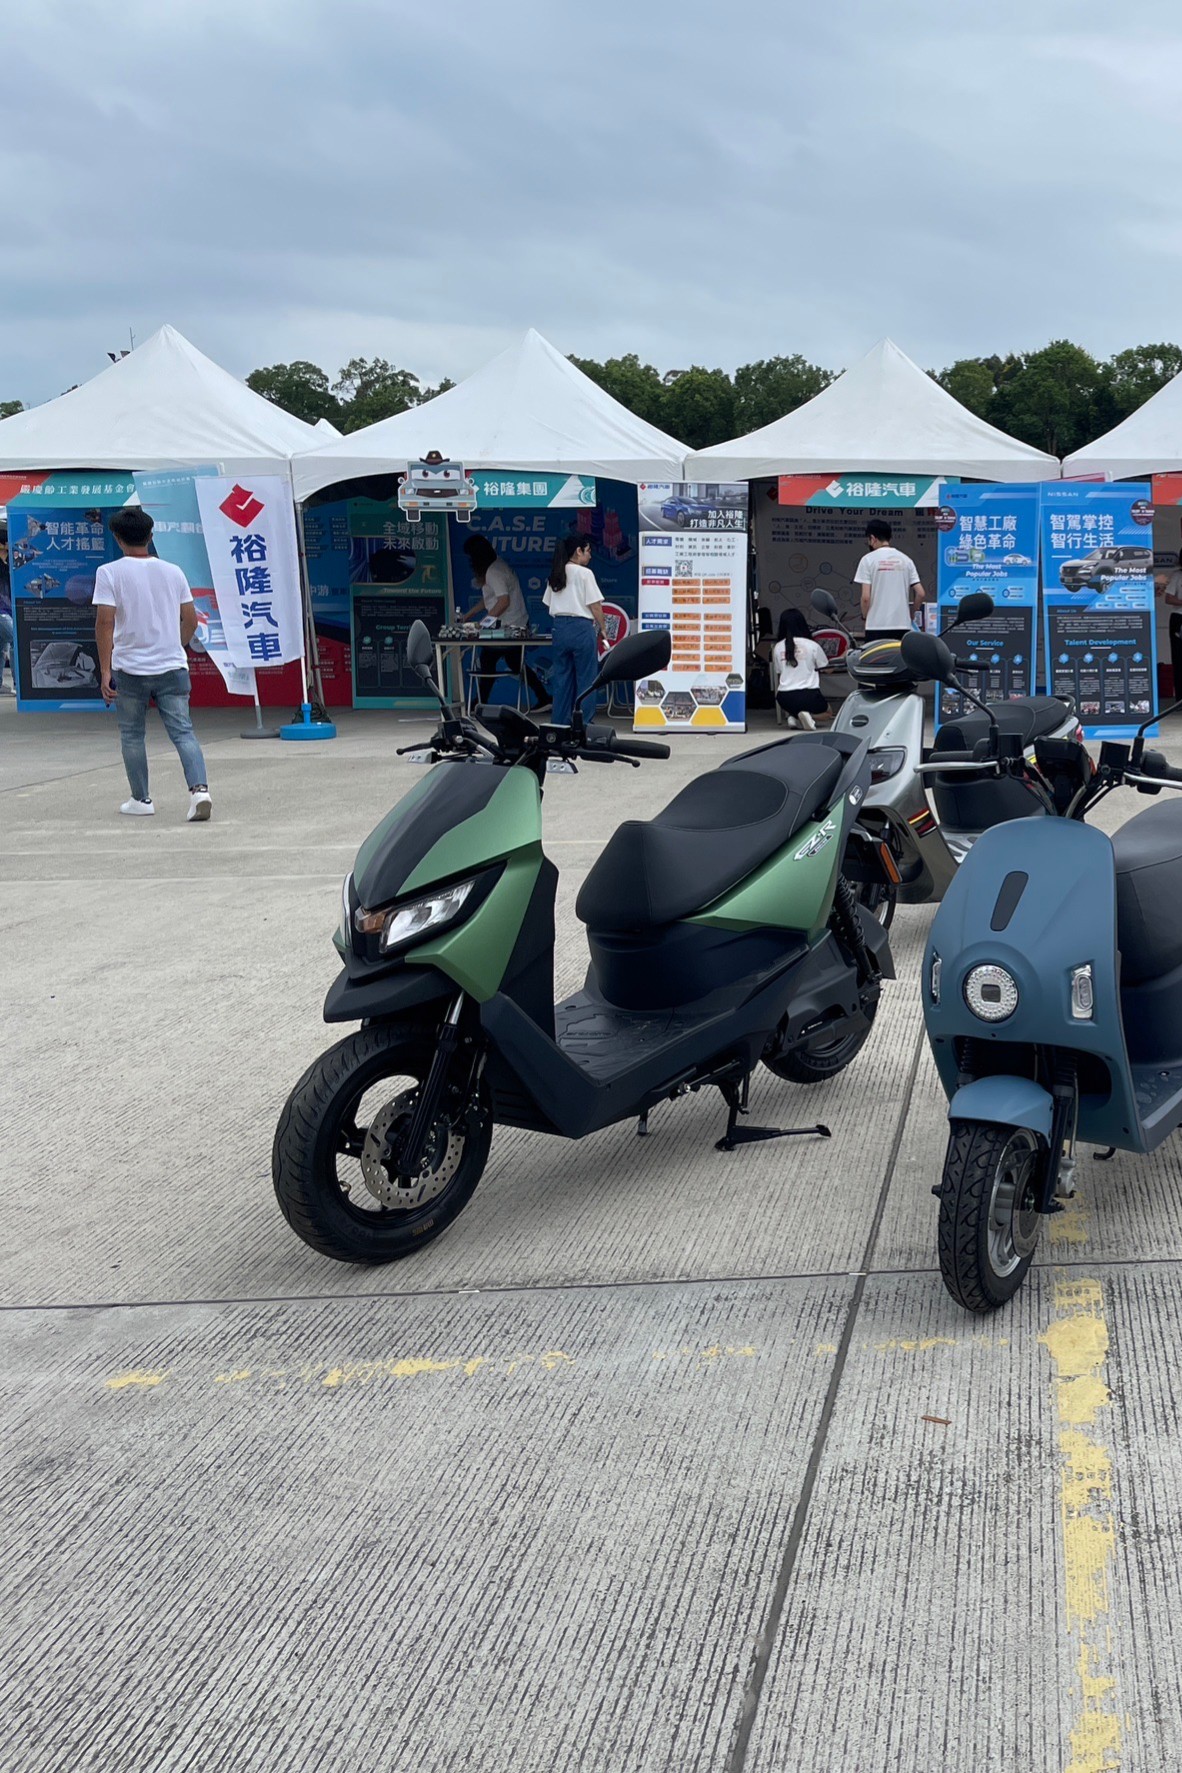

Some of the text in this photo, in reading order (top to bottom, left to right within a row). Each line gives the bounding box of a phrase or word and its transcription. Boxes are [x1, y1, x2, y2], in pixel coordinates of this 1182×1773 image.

[484, 481, 548, 496] 裕隆集團
[846, 482, 916, 497] 裕隆汽車
[708, 510, 743, 519] 加入裕隆
[805, 506, 903, 517] Drive Your Dream
[45, 521, 104, 536] 智能革命
[383, 521, 439, 535] 全域移動
[959, 515, 1017, 531] 智慧工廠
[1050, 514, 1114, 531] 智駕掌控
[46, 537, 105, 551] 人才搖籃
[383, 537, 439, 551] 未來啟動
[489, 536, 558, 552] UTURE
[958, 533, 1016, 550] 綠色革命
[1050, 533, 1115, 549] 智行生活
[229, 534, 282, 661] 裕隆汽車
[966, 639, 1004, 647] Our Service
[1088, 638, 1136, 647] Development
